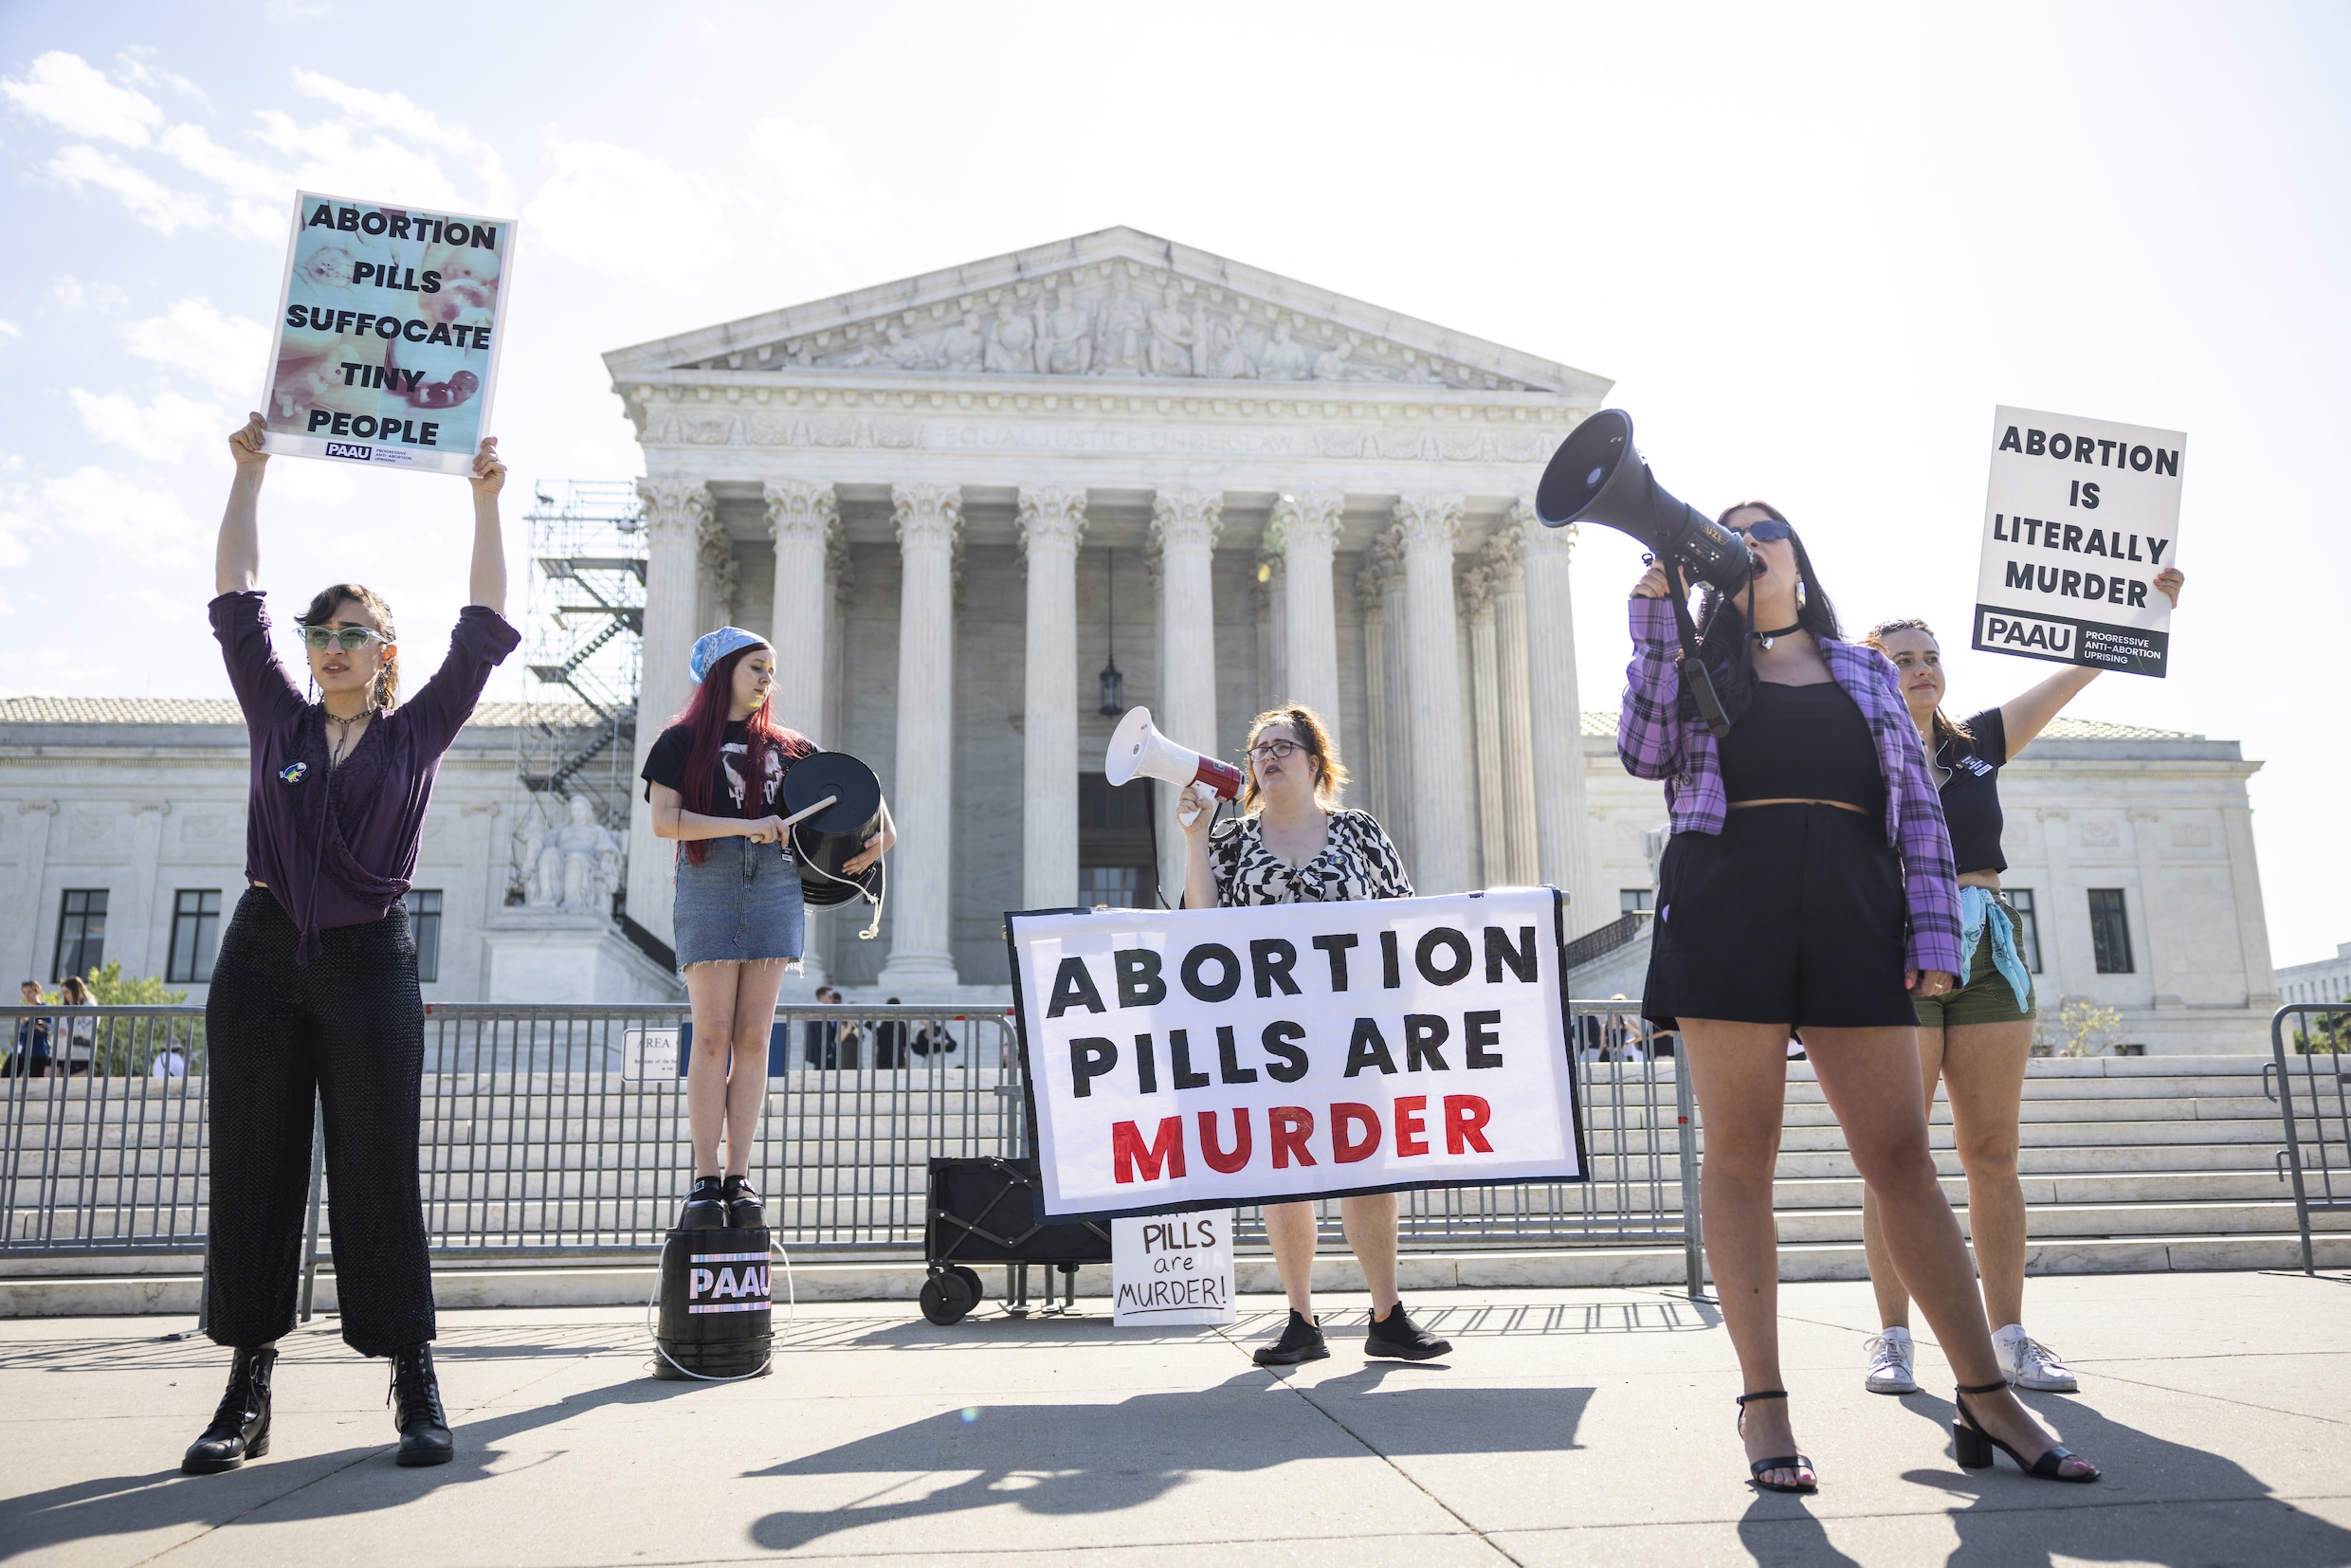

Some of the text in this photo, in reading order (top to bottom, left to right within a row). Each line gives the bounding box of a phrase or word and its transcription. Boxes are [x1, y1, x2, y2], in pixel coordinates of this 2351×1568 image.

[308, 204, 497, 250] ABORTION
[352, 261, 443, 294] PILLS
[285, 304, 491, 350] SUFFOCATE
[340, 362, 427, 392] TINY
[306, 409, 439, 446] PEOPLE
[944, 427, 1294, 452] EQUAL JUSTICE UNDER LAW
[328, 444, 370, 459] PAAU
[1998, 426, 2178, 477] ABORTION
[2069, 480, 2101, 509] IS
[1705, 525, 1722, 542] UZI
[1994, 514, 2169, 565] LITERALLY
[2005, 560, 2148, 609] MURDER
[1987, 617, 2071, 652] PAAU
[2085, 641, 2161, 660] ANTI-ABORTION
[2086, 630, 2150, 647] PROGRESSIVE
[2084, 650, 2128, 665] UPRISING
[1046, 926, 1538, 1018] ABORTION
[1069, 1010, 1504, 1098] PILLS ARE
[1112, 1094, 1494, 1184] MURDER
[1142, 1219, 1216, 1254] PILLS
[1154, 1256, 1194, 1273] are
[689, 1266, 772, 1300] PAAU
[1117, 1276, 1227, 1308] MURDER!
